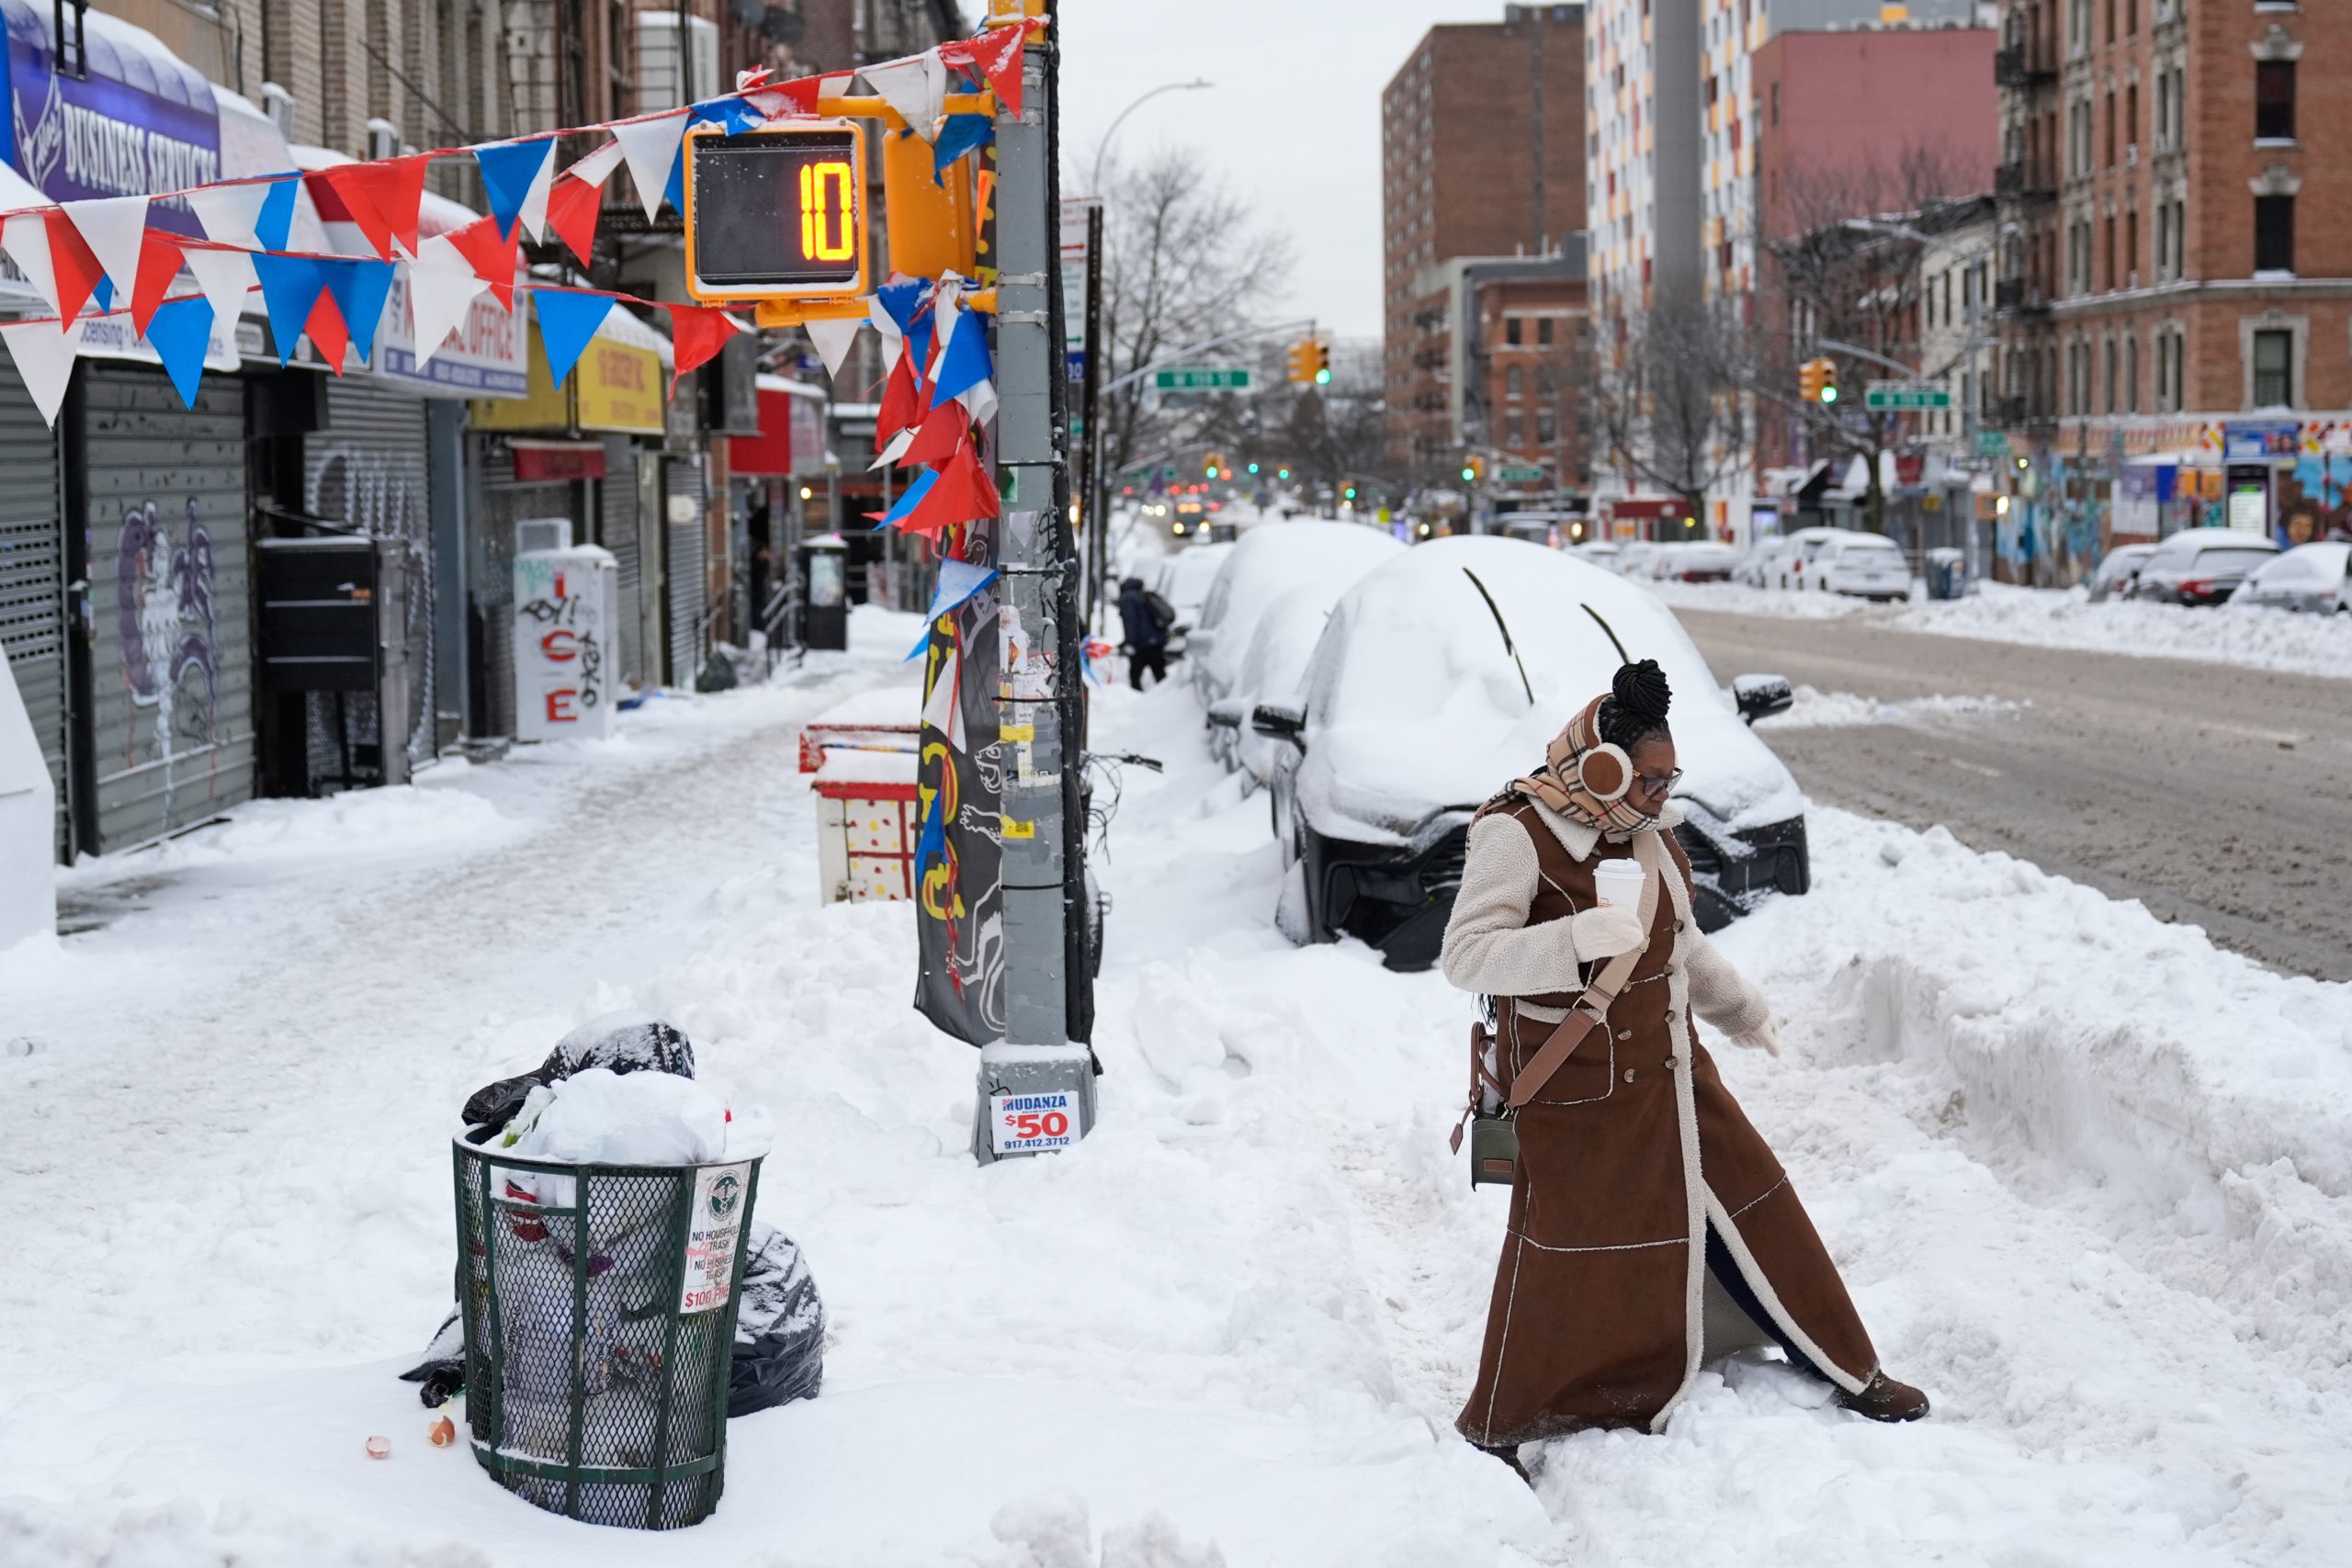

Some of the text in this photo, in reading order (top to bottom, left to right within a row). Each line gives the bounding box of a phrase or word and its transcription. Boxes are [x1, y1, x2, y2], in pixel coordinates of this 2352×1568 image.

[62, 101, 146, 197] BUSINESS
[148, 130, 217, 197] SERVICES
[800, 162, 854, 261] 10
[1002, 1096, 1068, 1111] MUDANZA
[1005, 1112, 1069, 1139] $50
[1004, 1136, 1069, 1149] 917.412.3712
[692, 1232, 705, 1241] NO
[709, 1238, 730, 1252] TRASH
[695, 1260, 706, 1270] NO
[685, 1290, 712, 1308] $100
